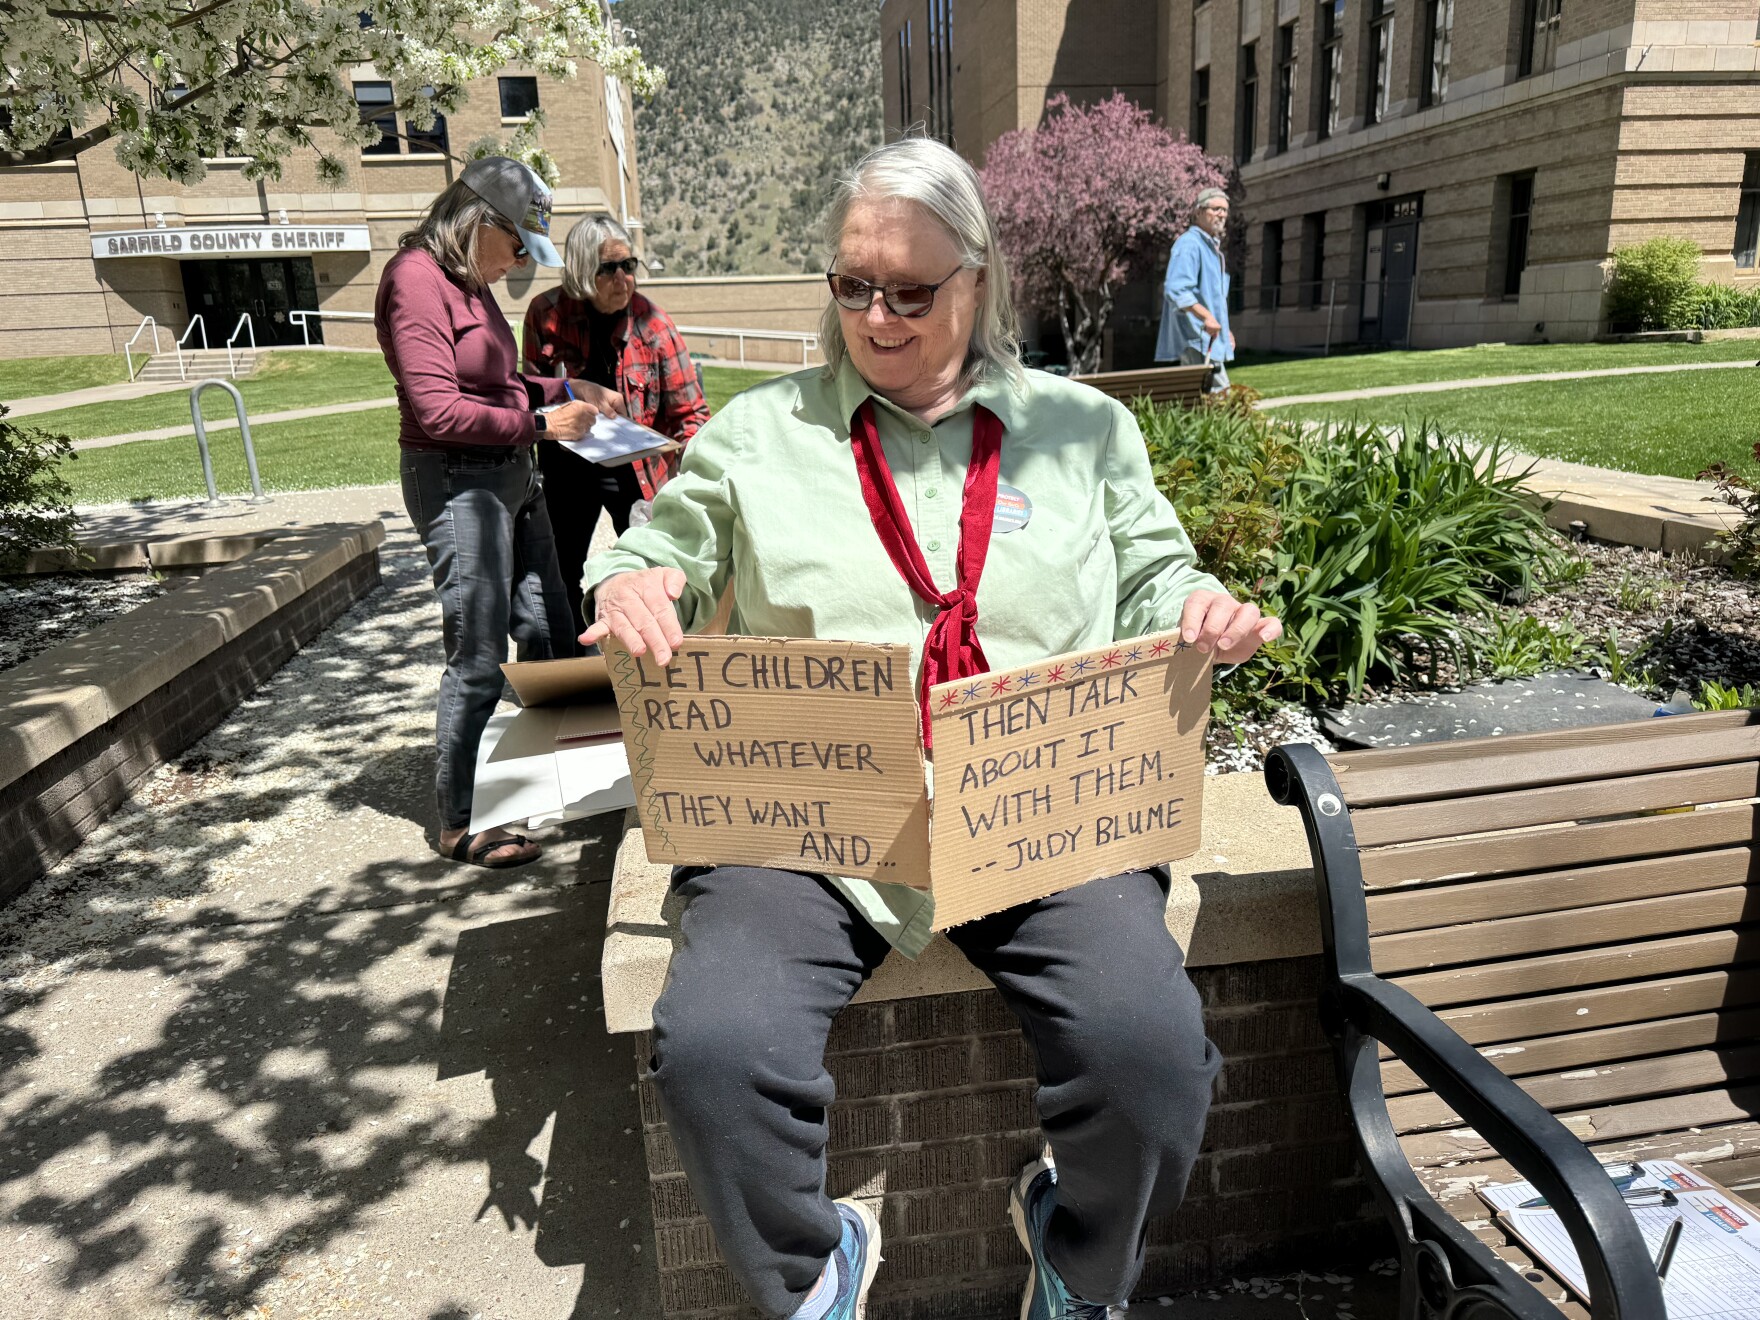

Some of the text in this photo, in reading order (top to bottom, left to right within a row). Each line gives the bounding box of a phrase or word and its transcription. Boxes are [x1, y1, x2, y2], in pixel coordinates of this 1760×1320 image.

[190, 232, 262, 250] COUNTY
[271, 231, 345, 249] SHERIFF
[634, 651, 894, 697] LET CHILDREN
[644, 699, 732, 732] READ
[959, 670, 1138, 746] THEN TALK
[694, 739, 884, 775] WHATEVER
[959, 721, 1126, 794] ABOUT IT
[655, 791, 831, 828] THEY WANT
[961, 750, 1175, 839] WITH THEM.
[1096, 797, 1185, 847] BLUME
